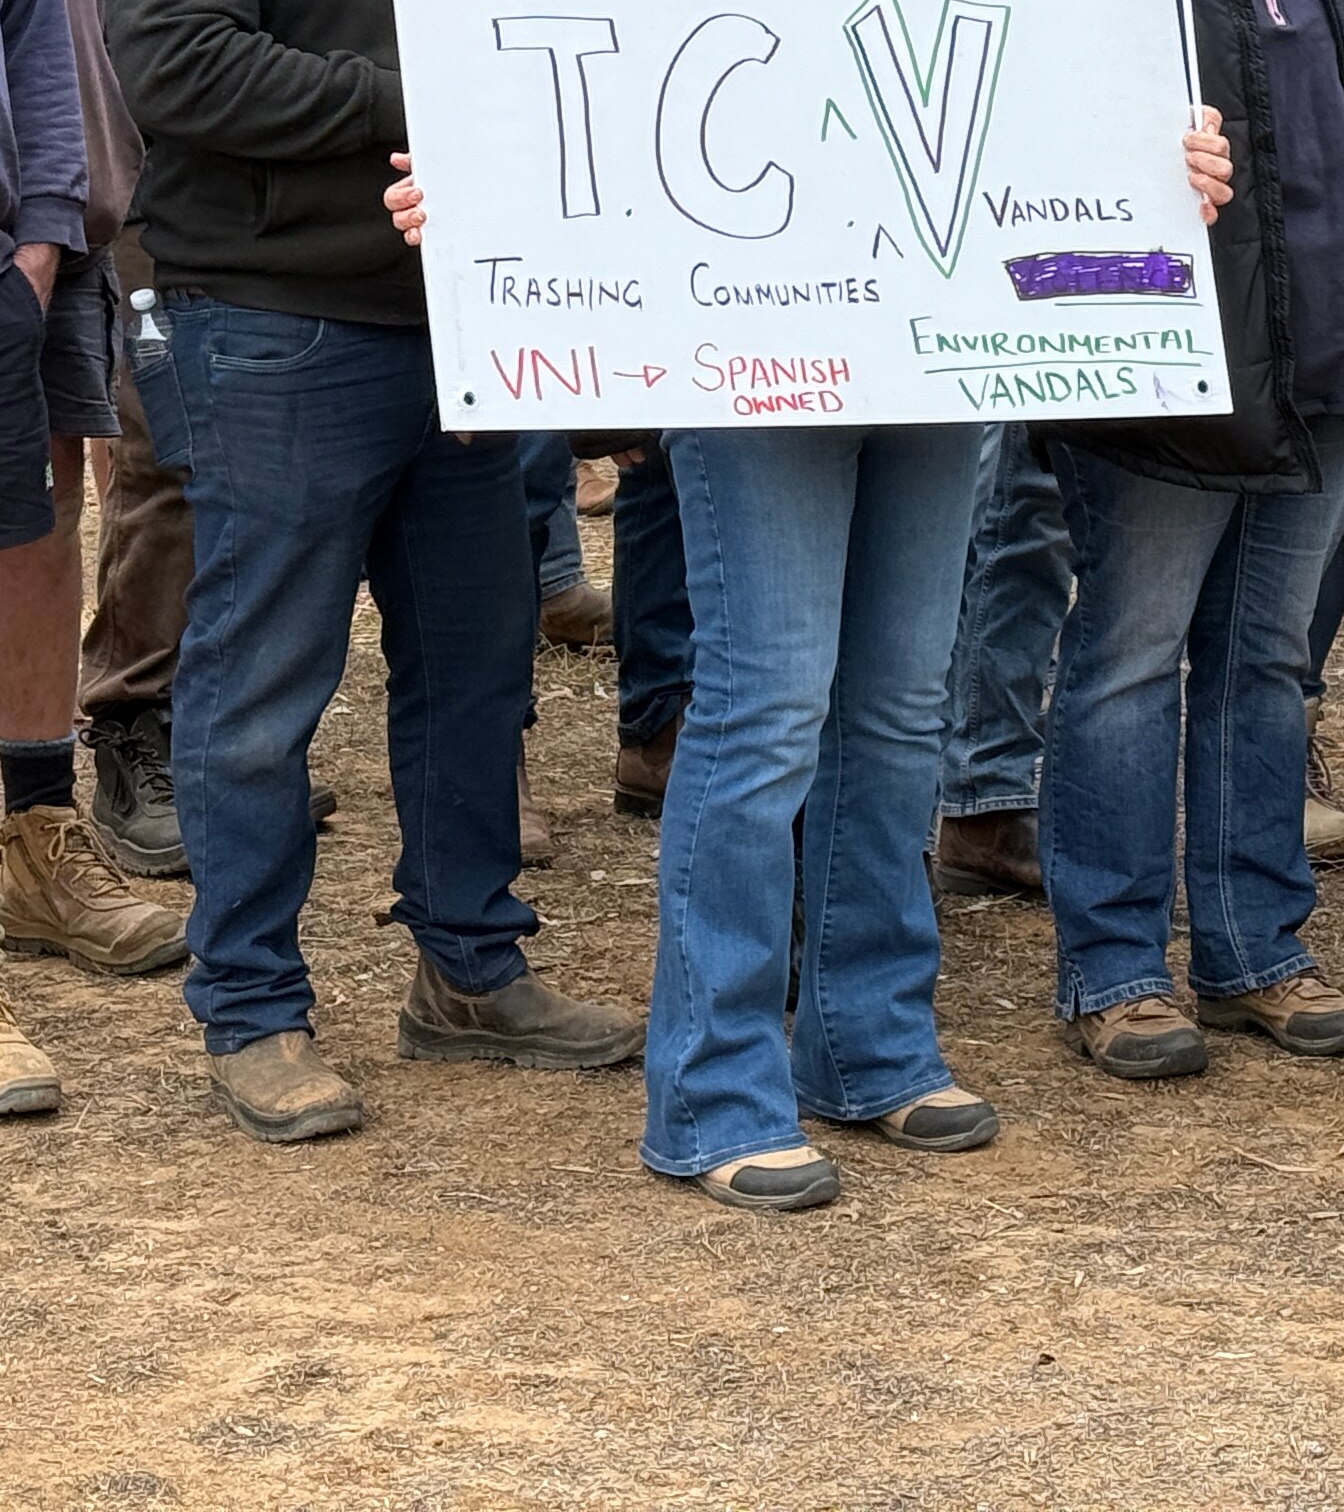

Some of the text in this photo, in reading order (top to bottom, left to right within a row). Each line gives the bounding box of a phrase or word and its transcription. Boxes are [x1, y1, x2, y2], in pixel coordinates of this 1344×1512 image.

[490, 345, 602, 401] VNI
[957, 367, 1138, 411] VANDALS
[733, 390, 844, 416] OWNED
